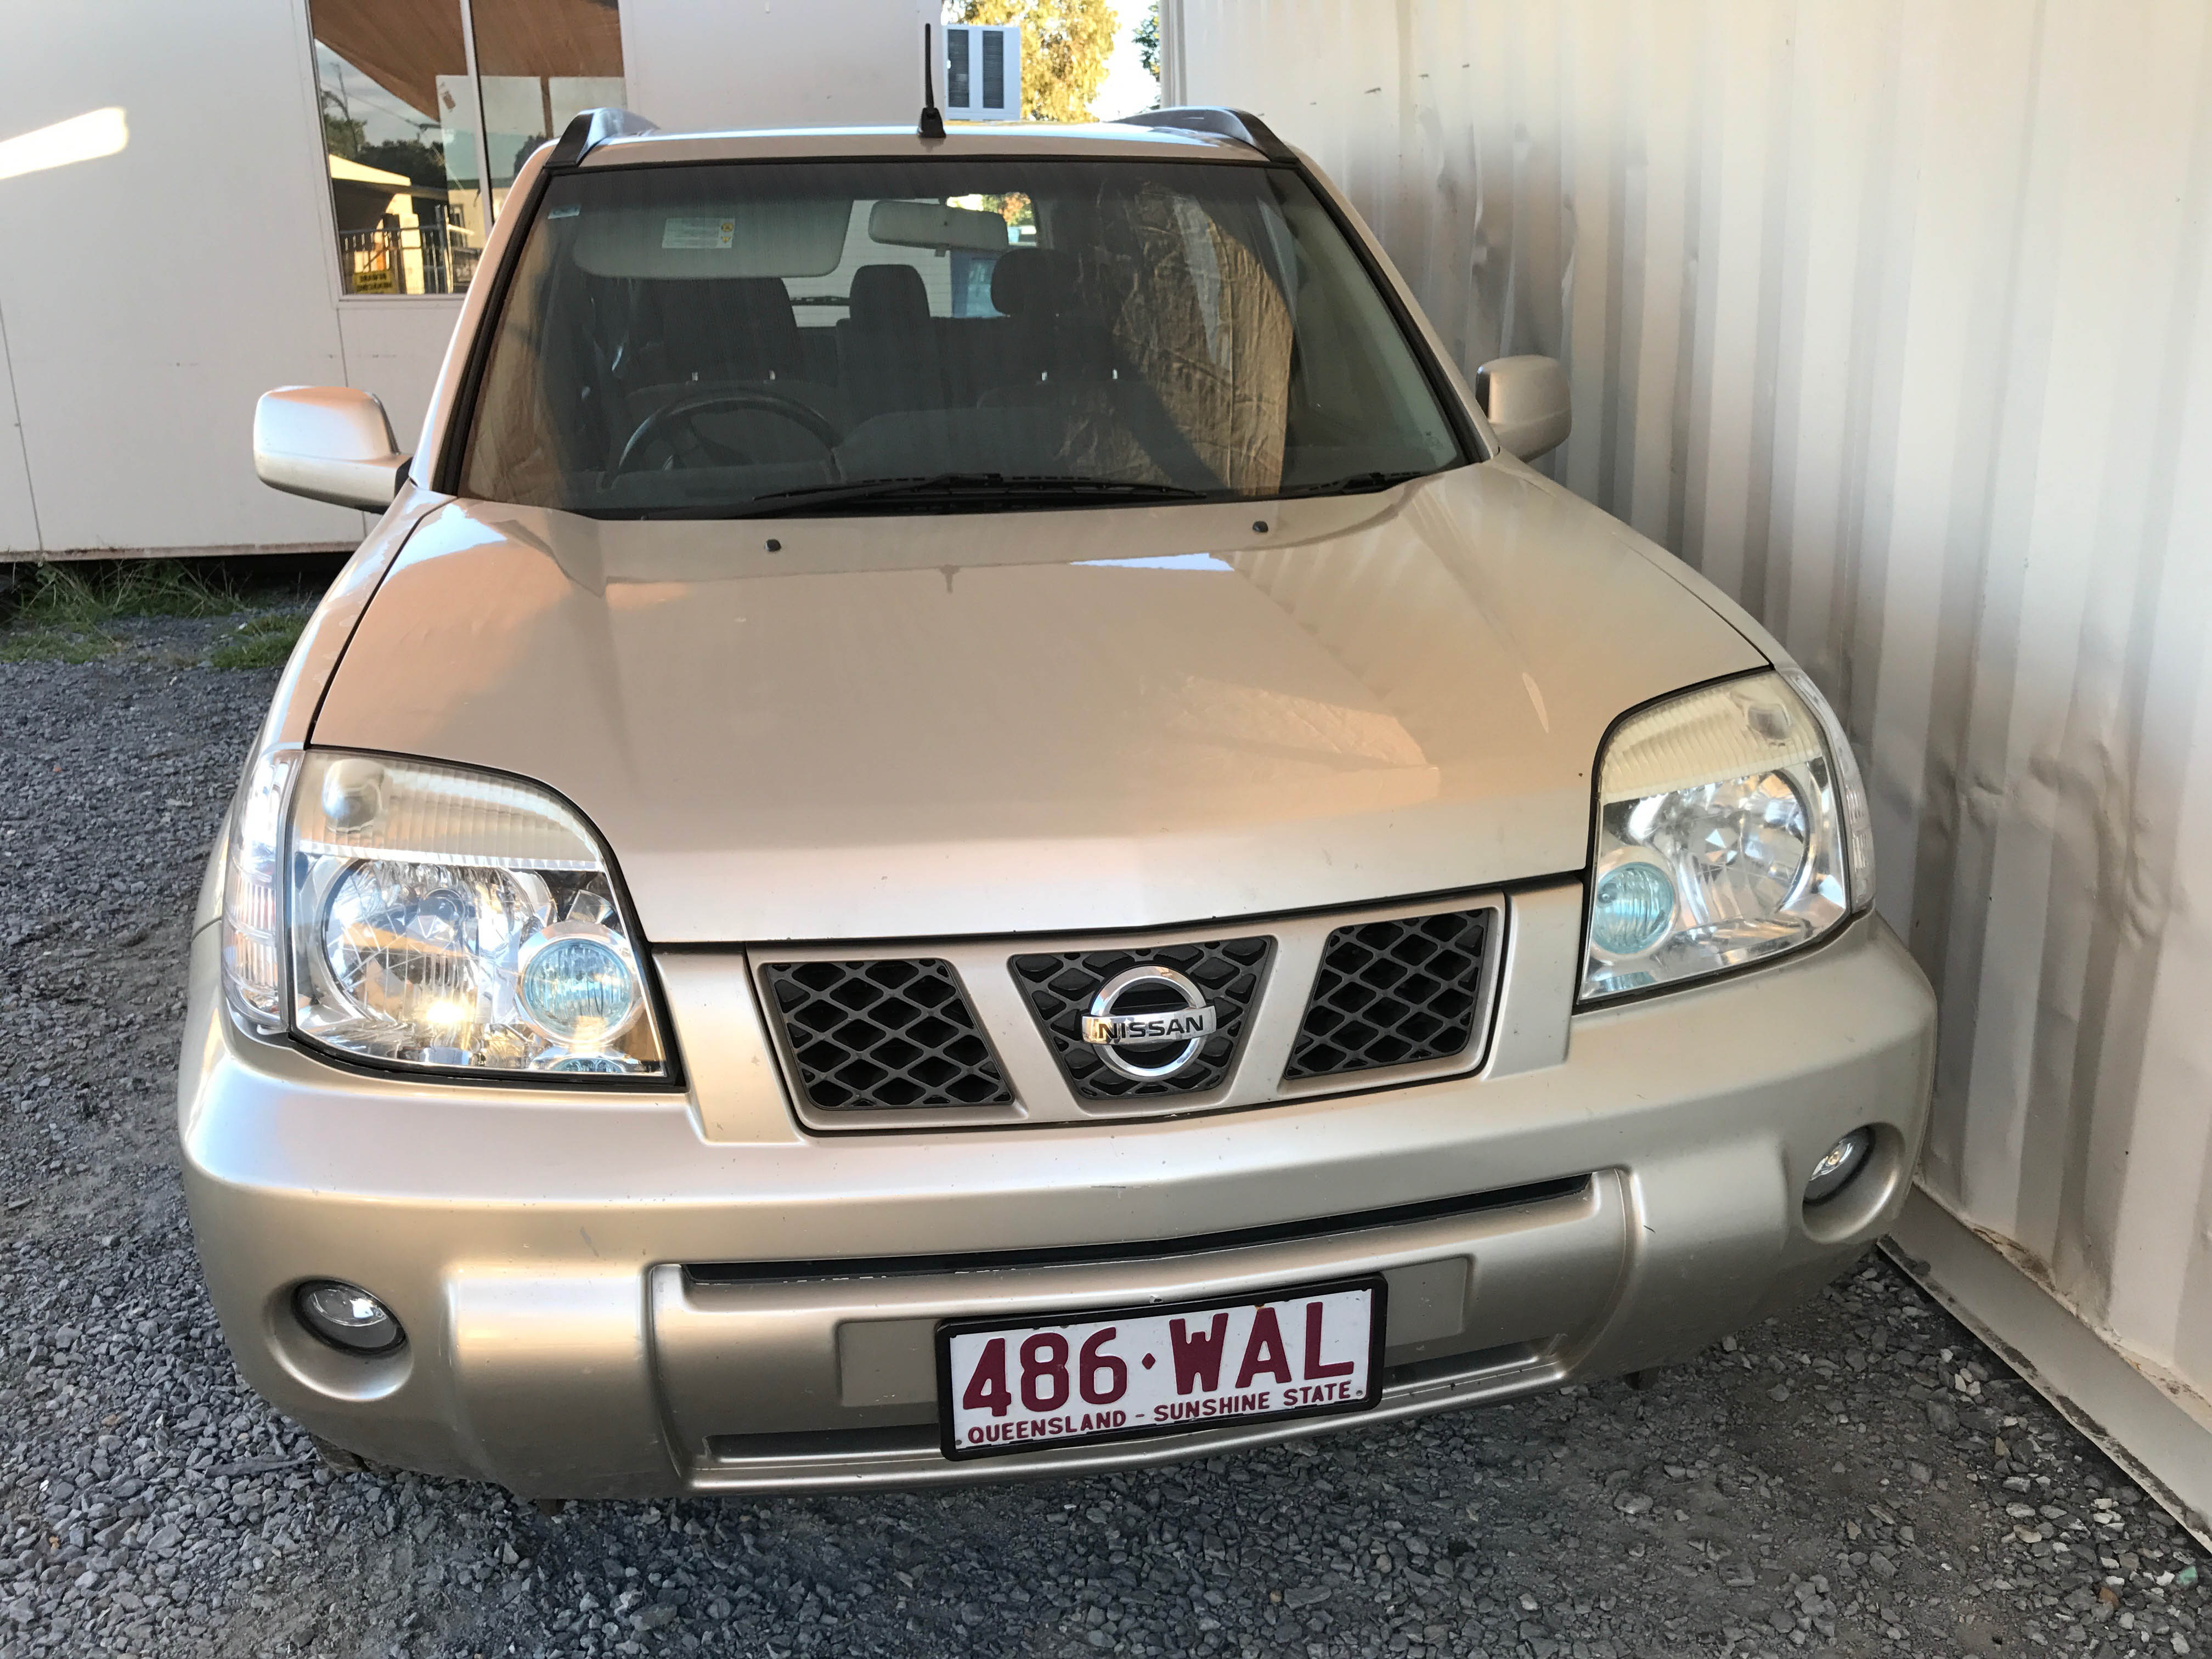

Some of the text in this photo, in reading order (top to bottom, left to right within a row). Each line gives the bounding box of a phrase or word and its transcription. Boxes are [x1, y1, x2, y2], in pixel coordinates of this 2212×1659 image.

[1098, 1014, 1204, 1039] NISSAN
[963, 1302, 1354, 1417] 486 WAL
[968, 1410, 1126, 1444] QUEENSLAND
[1153, 1391, 1271, 1422] SUNSHINE
[1283, 1380, 1352, 1407] STATE
